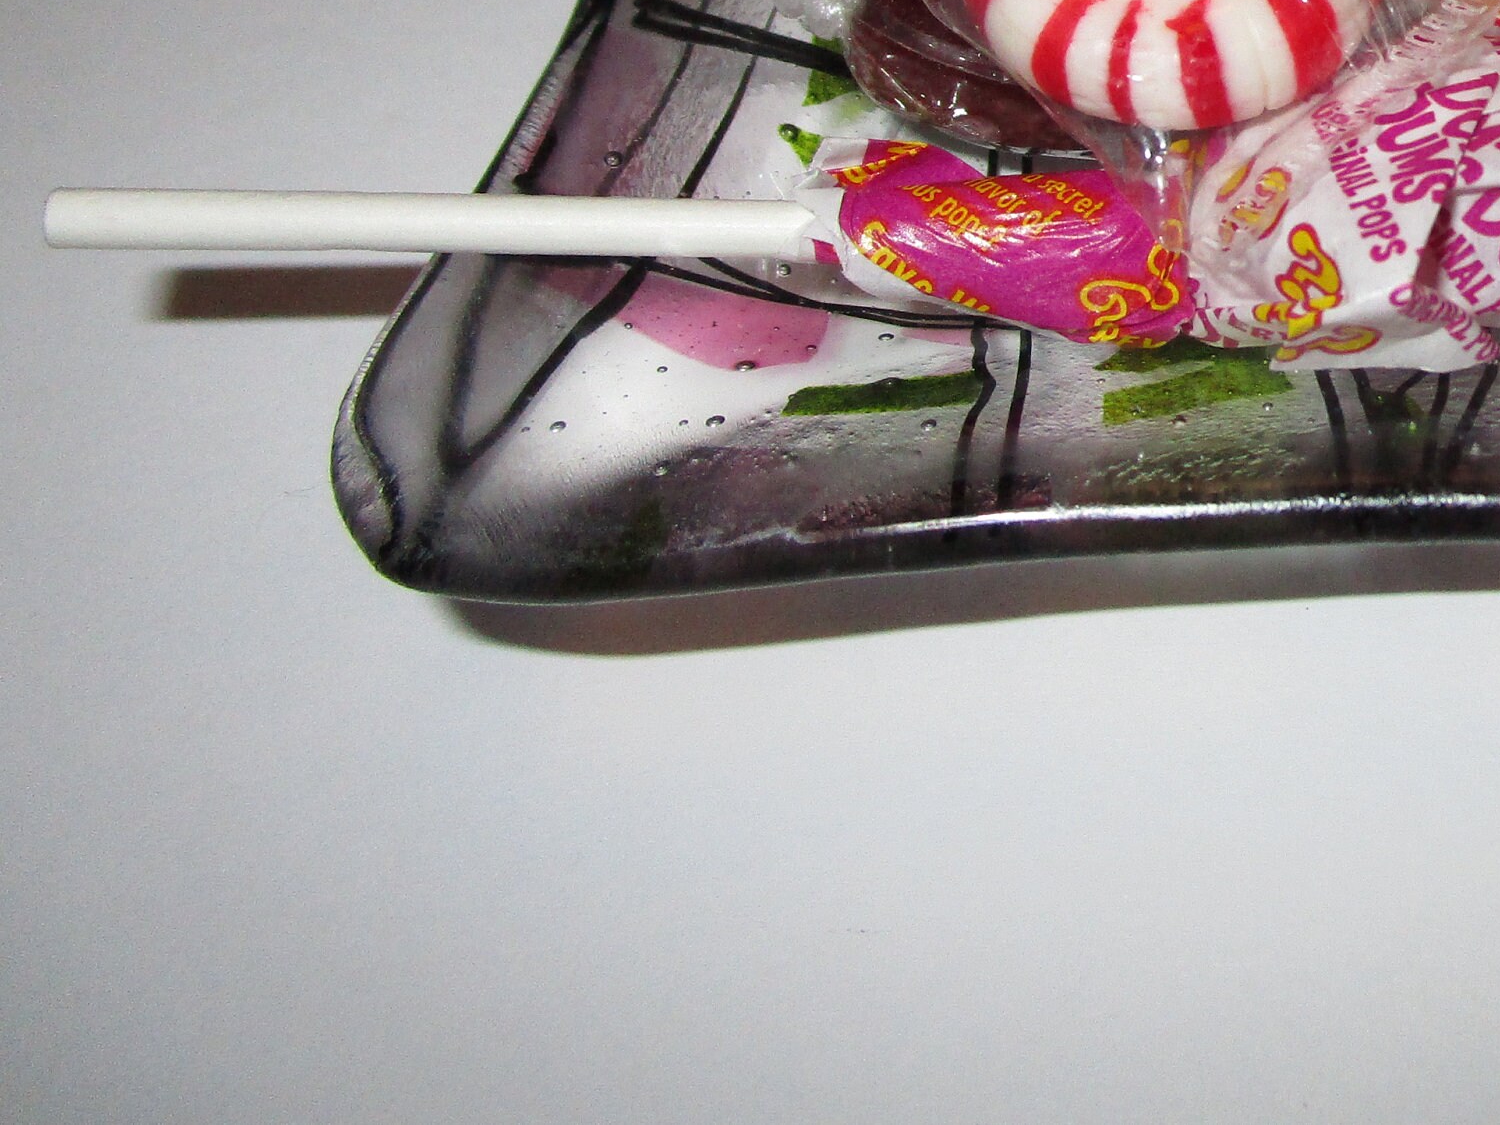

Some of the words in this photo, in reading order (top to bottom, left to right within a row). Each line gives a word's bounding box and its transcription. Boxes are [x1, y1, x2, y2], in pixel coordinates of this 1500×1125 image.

[1038, 176, 1106, 220] secret
[1021, 207, 1064, 236] of
[1349, 194, 1408, 264] POPS
